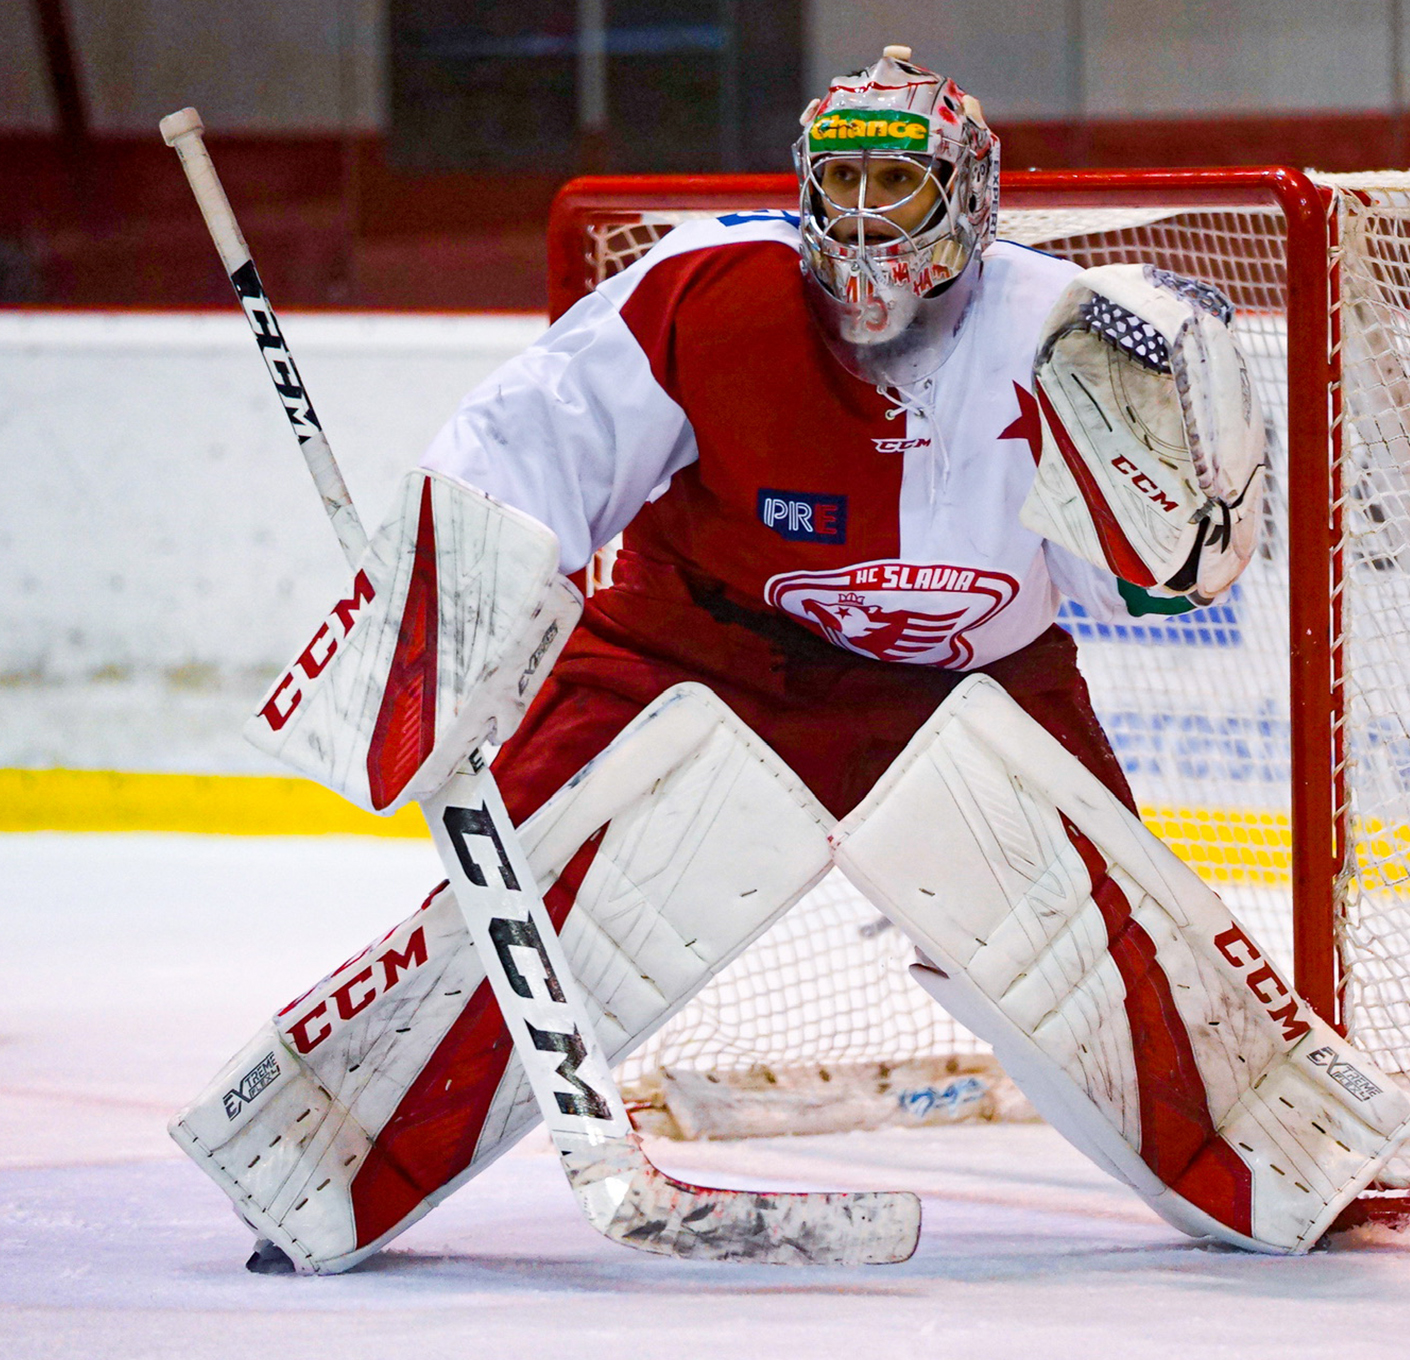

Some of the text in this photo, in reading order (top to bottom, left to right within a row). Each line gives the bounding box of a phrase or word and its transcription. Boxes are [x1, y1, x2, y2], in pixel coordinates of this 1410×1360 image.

[810, 114, 928, 140] Chance
[242, 295, 322, 440] CCM
[872, 438, 933, 453] CCM
[1111, 454, 1180, 513] CCM
[763, 497, 838, 536] PRE
[855, 566, 976, 592] HC SLAVIA
[256, 568, 376, 732] CCM
[285, 925, 428, 1054] CCM
[441, 799, 614, 1121] CCM
[1214, 920, 1312, 1042] CCM
